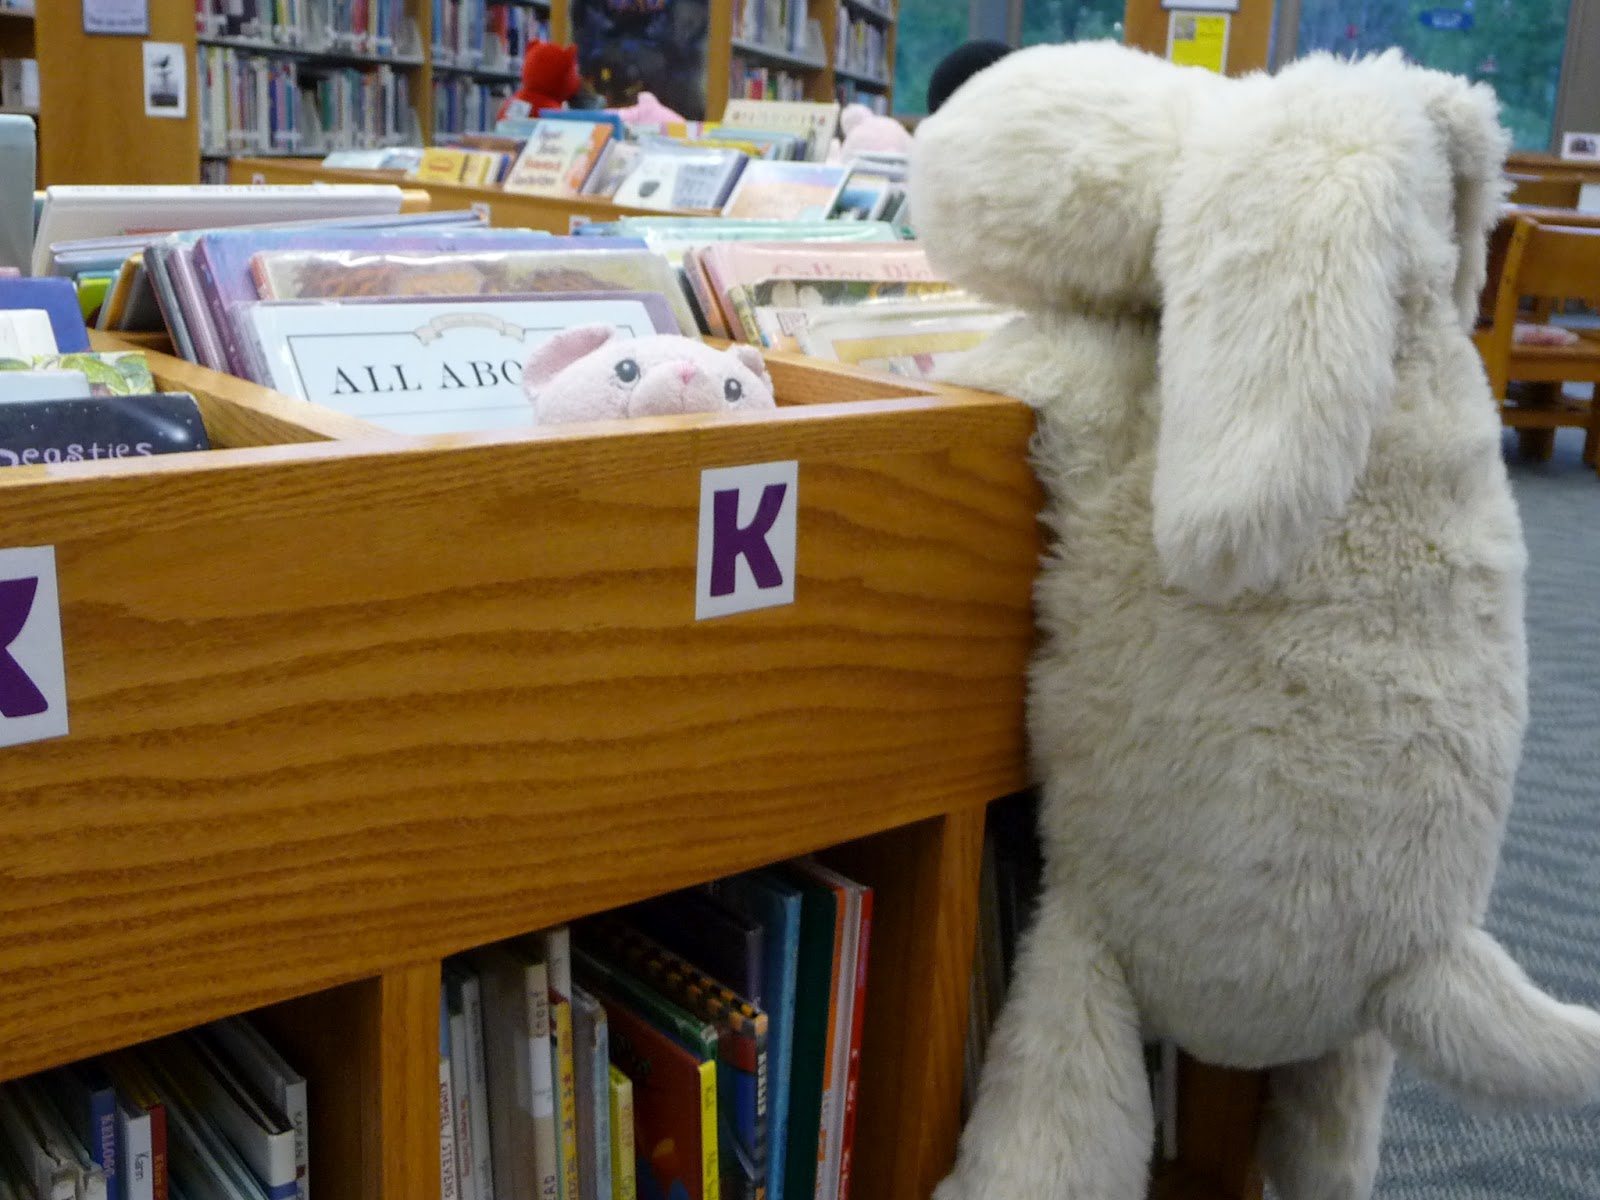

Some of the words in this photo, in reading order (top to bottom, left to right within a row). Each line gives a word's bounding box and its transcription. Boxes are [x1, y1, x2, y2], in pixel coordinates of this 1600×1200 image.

[333, 364, 422, 394] ALL
[710, 482, 787, 597] K
[441, 1143, 455, 1199] STEVENS
